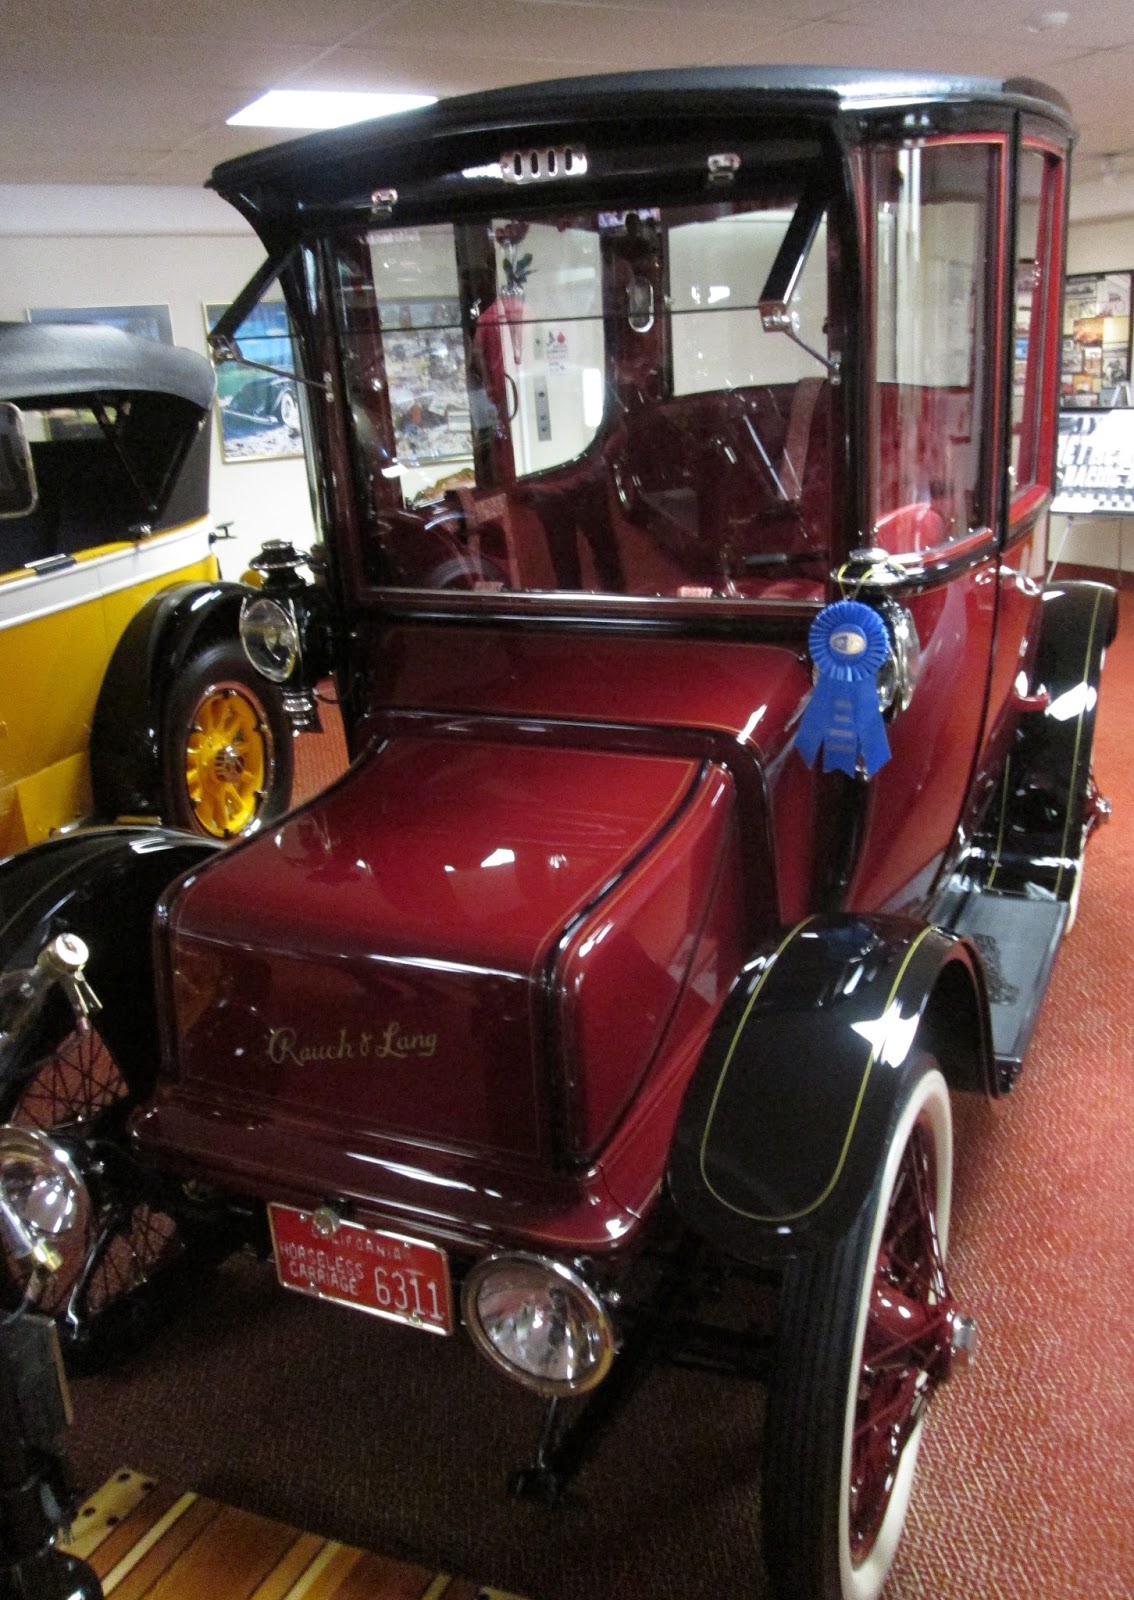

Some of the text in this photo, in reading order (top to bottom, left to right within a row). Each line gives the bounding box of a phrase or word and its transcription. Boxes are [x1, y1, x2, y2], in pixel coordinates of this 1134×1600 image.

[267, 1027, 354, 1066] Rauch
[375, 1021, 437, 1057] Lang
[279, 1241, 365, 1279] HORSELESS
[312, 1225, 402, 1260] CLIFORNIA
[289, 1261, 358, 1296] CARRIAGE
[374, 1267, 443, 1321] 6311
